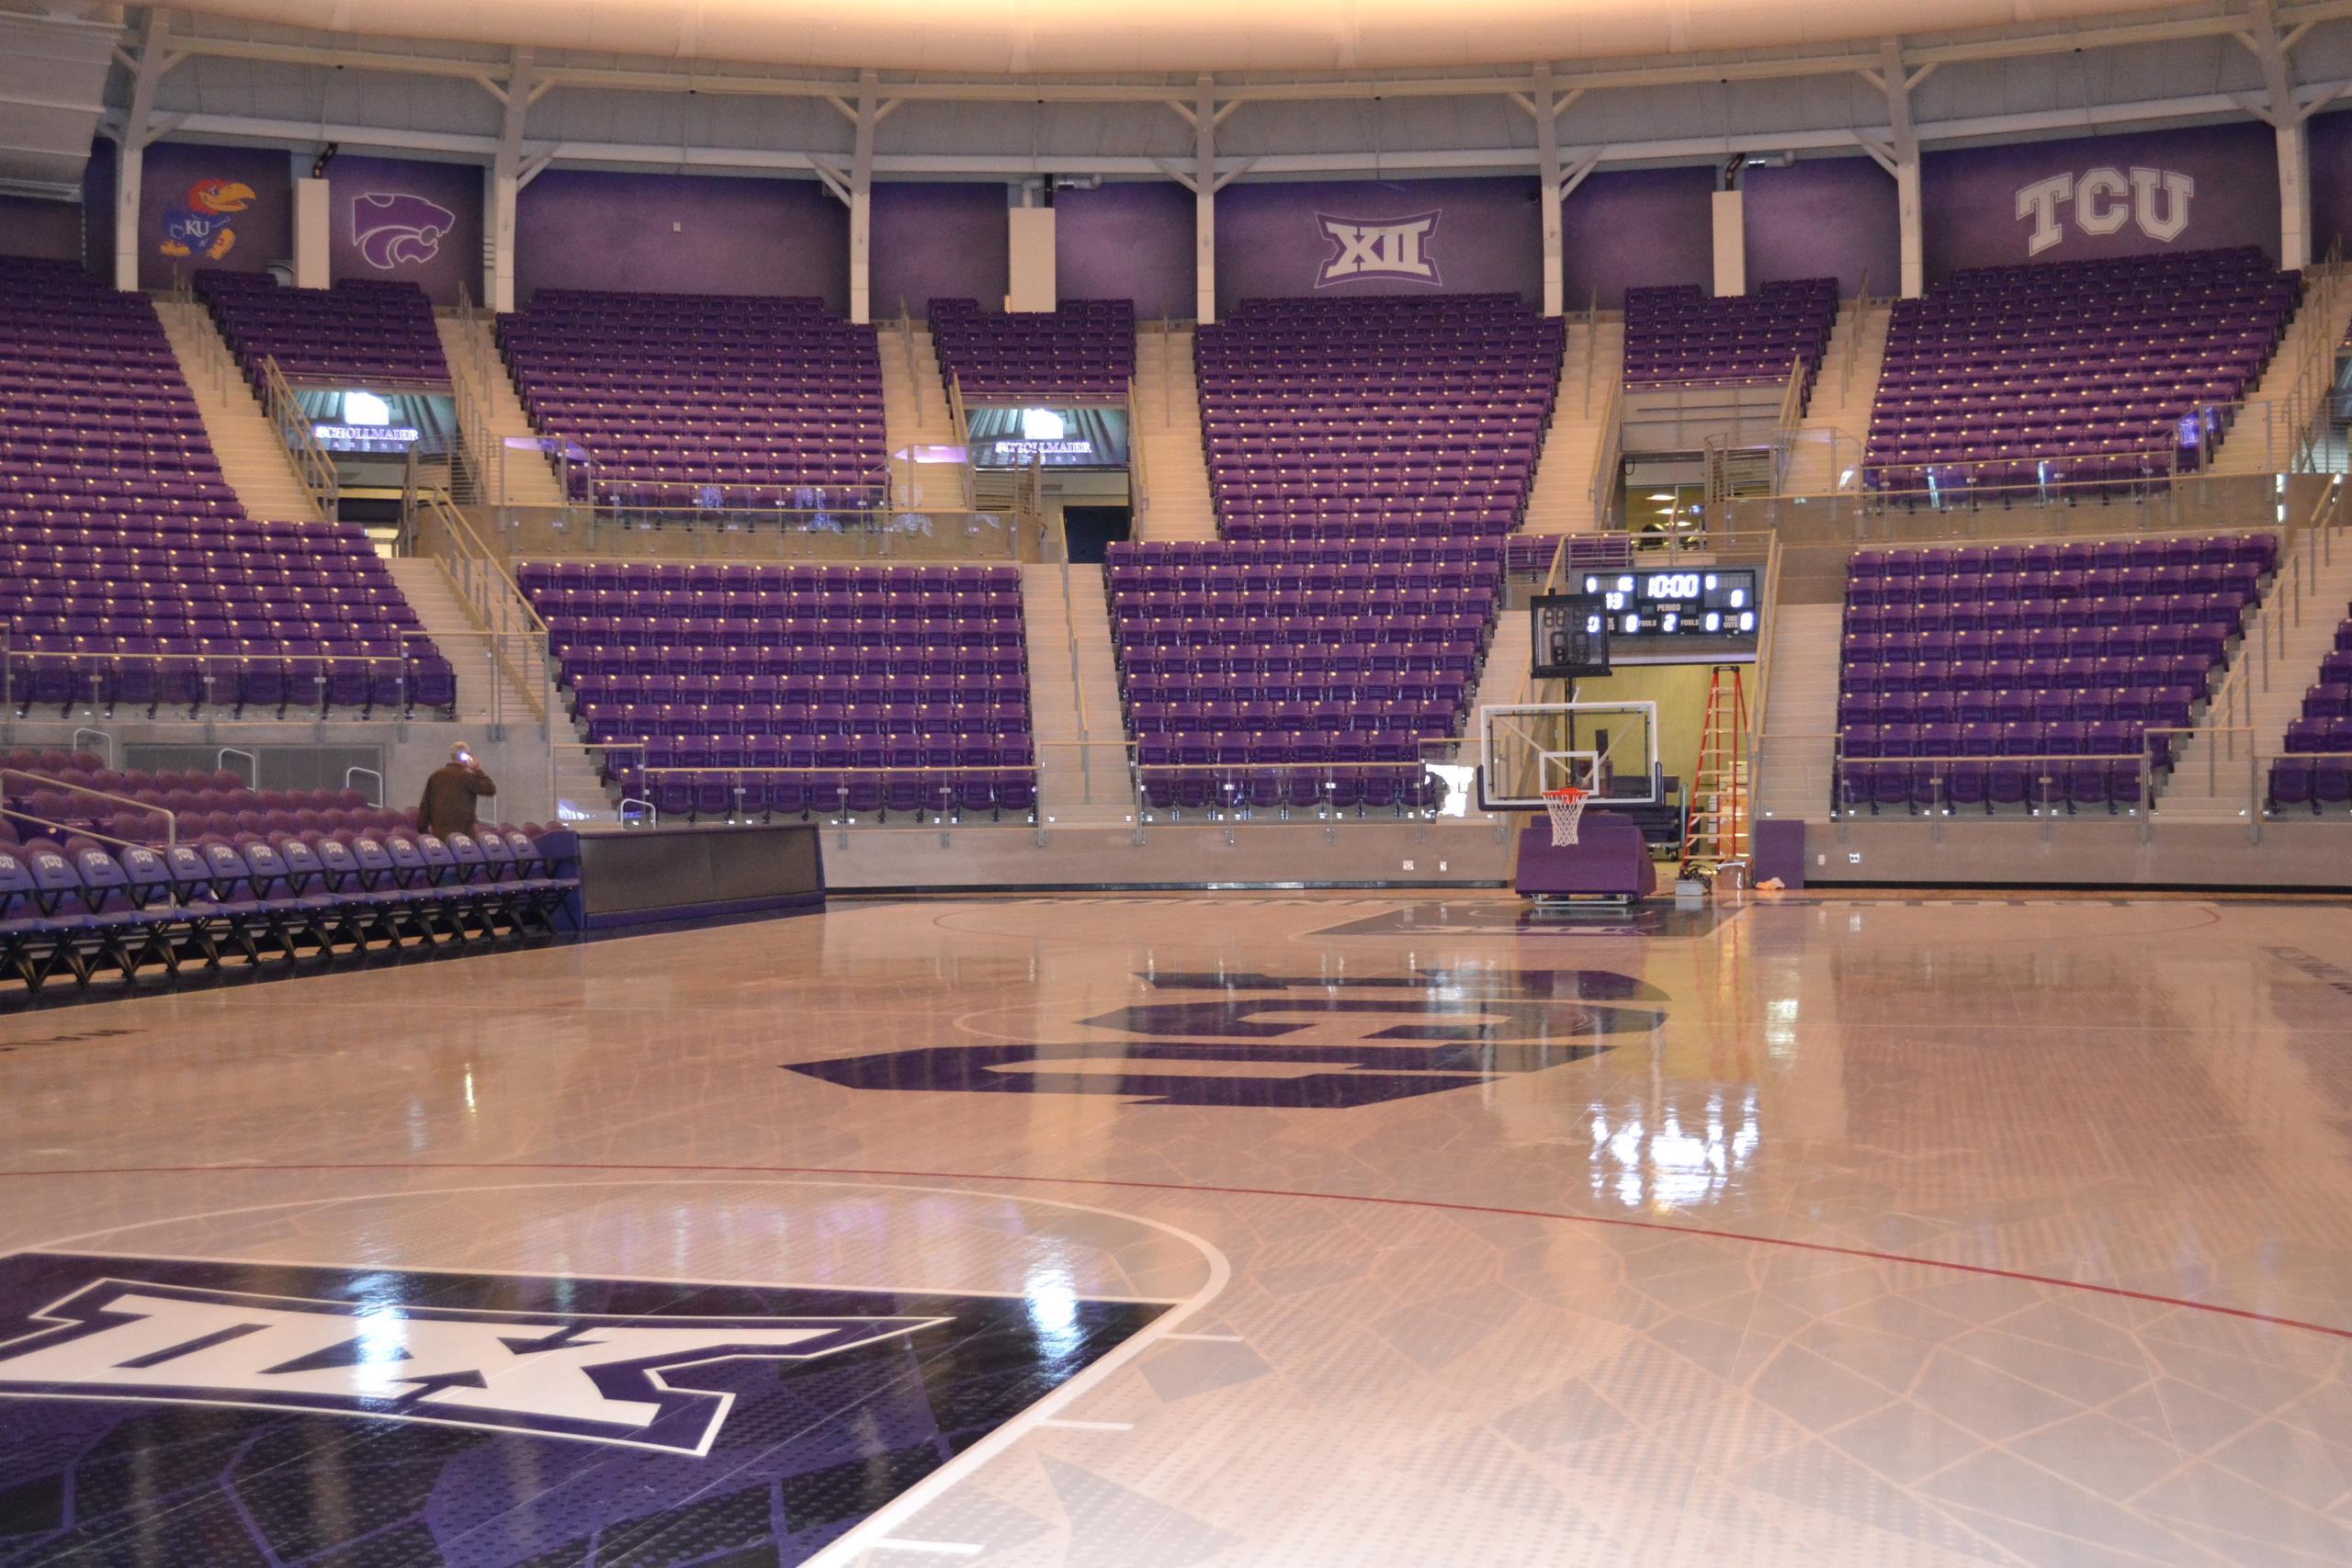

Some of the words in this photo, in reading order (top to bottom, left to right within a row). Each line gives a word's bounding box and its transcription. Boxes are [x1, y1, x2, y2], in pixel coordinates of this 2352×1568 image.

[2016, 166, 2194, 257] TCU
[185, 220, 210, 238] KU
[1325, 219, 1431, 278] XII
[315, 426, 419, 441] SCHOLLMAIER
[1648, 575, 1700, 598] 10:00
[1657, 604, 1681, 612] PERIOD
[213, 846, 233, 859] TCU
[252, 844, 272, 857] TCU
[288, 842, 308, 854] TCU
[324, 840, 345, 853] TCU
[359, 840, 379, 852] TCU
[40, 854, 63, 868] TCU
[86, 852, 110, 865] TCU
[131, 850, 154, 863] TCU
[175, 848, 195, 861] TCU
[0, 855, 15, 869] CU
